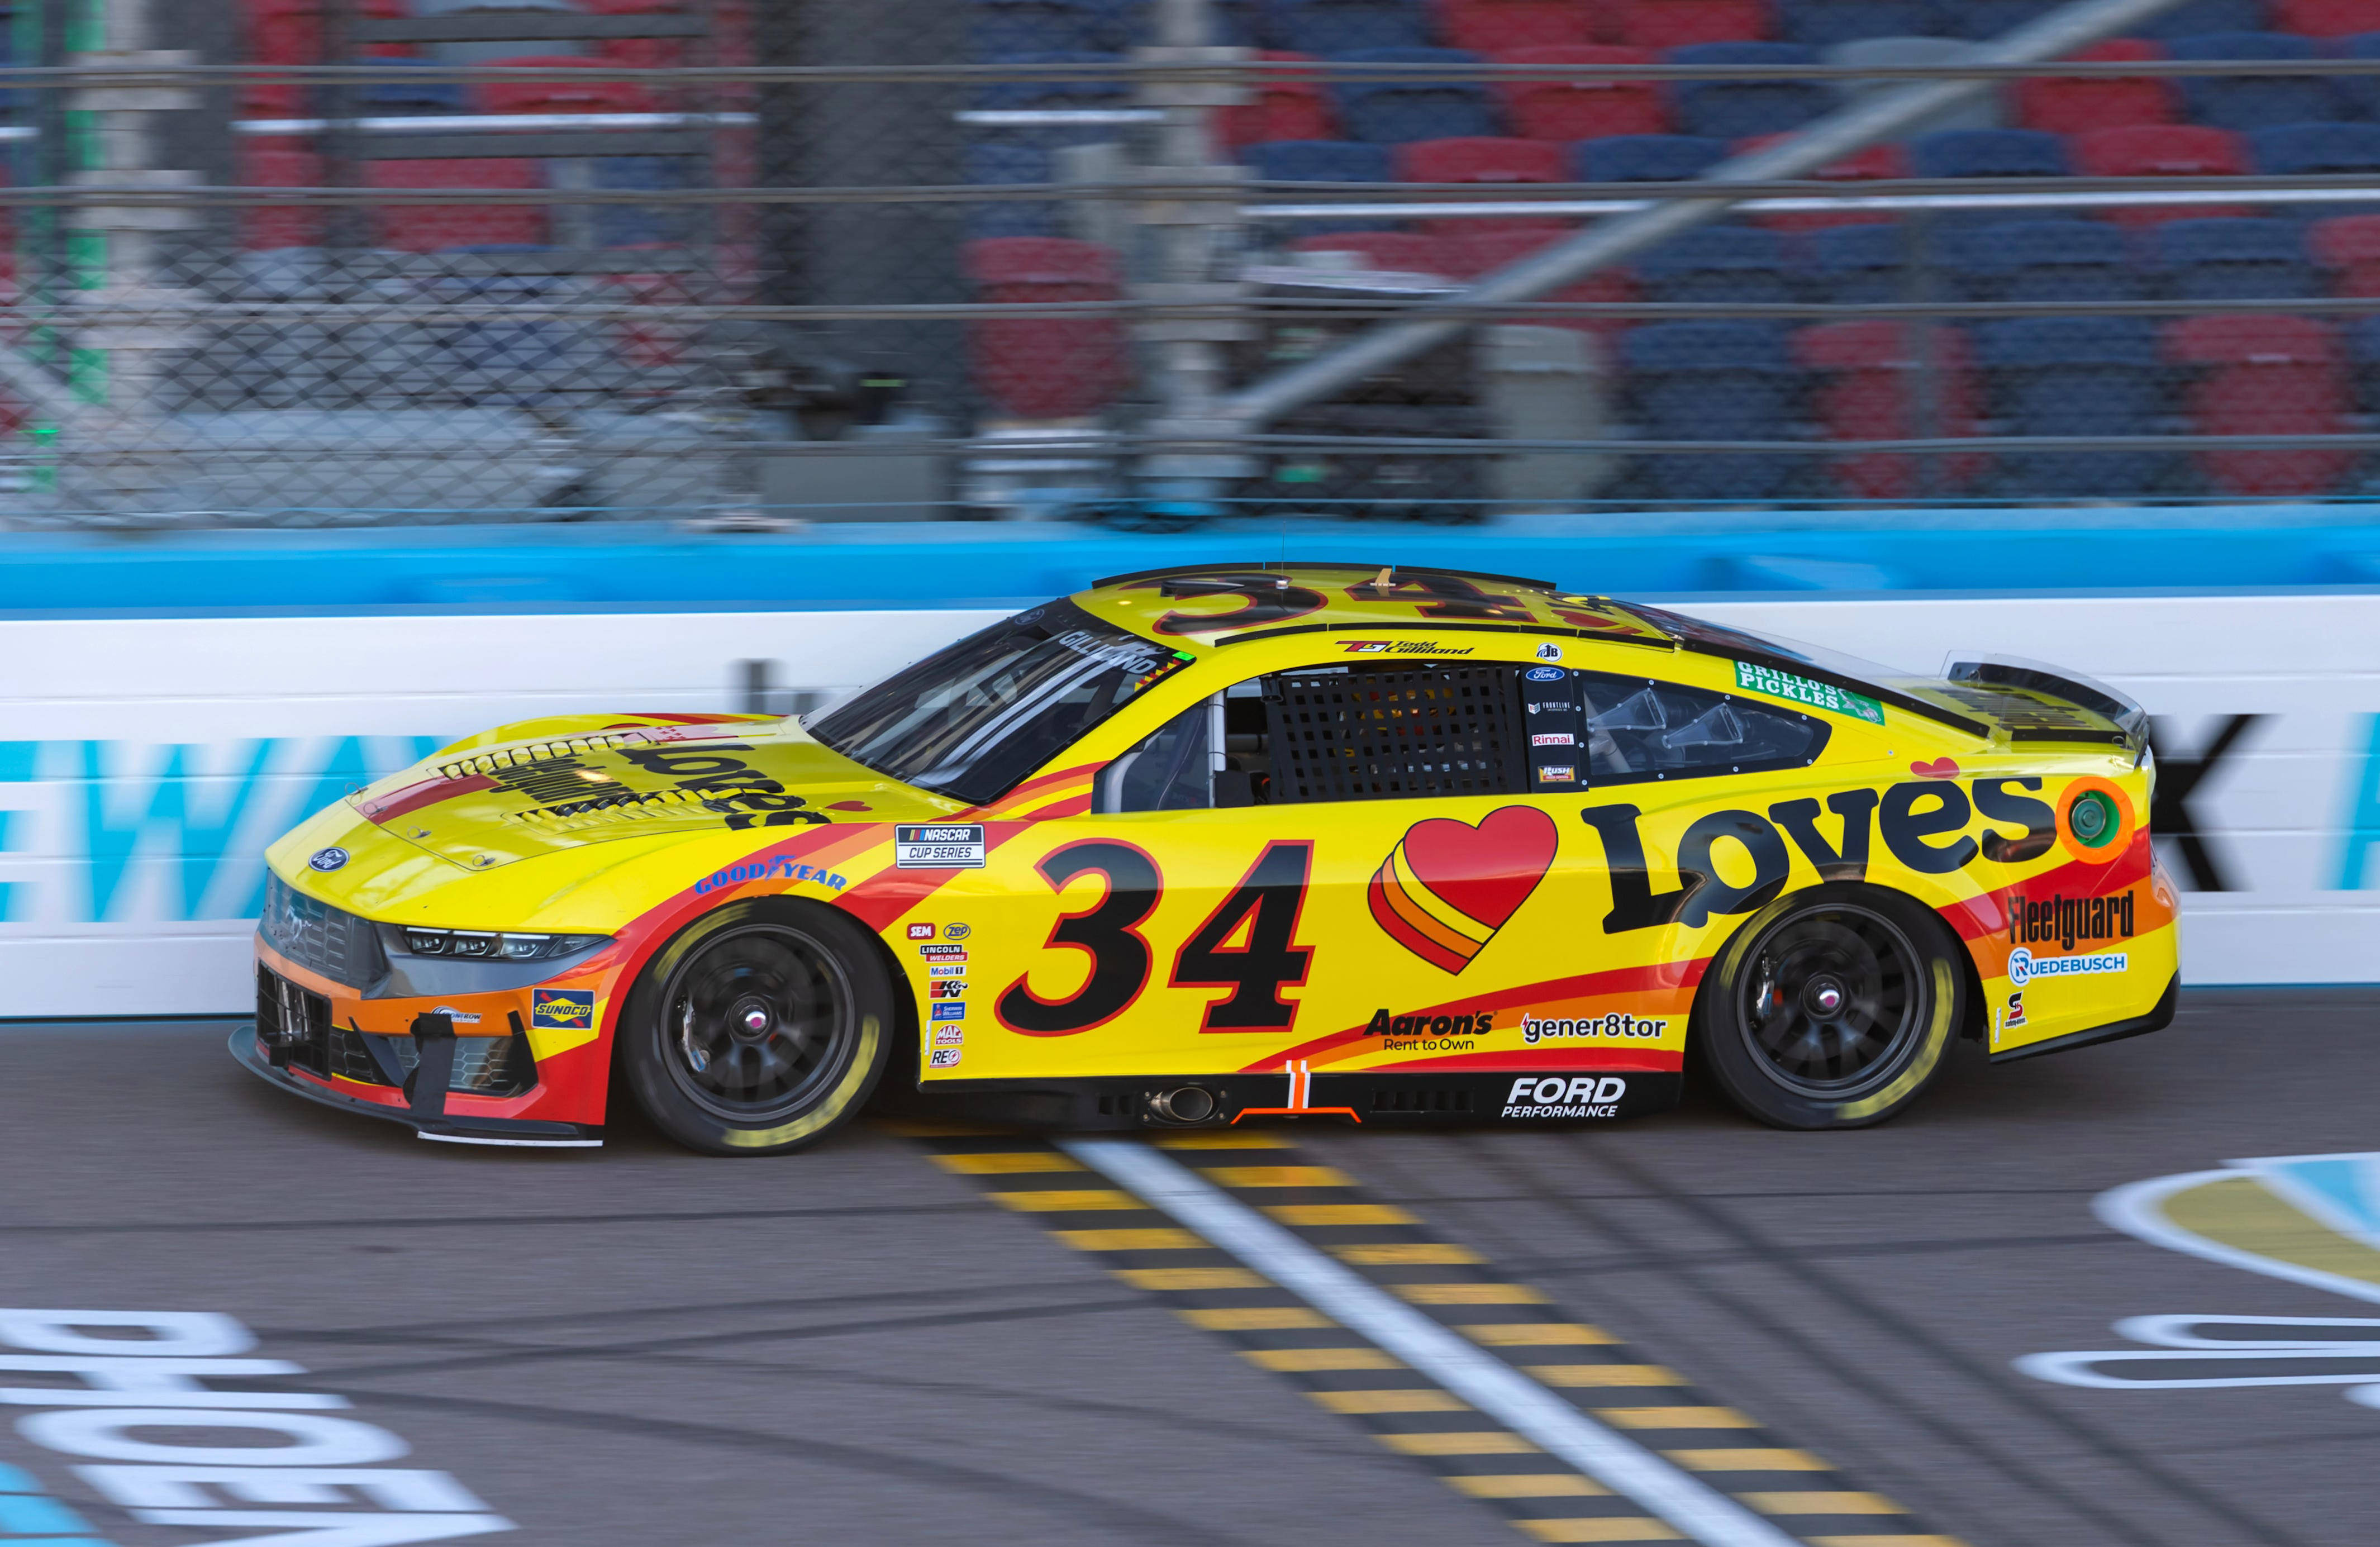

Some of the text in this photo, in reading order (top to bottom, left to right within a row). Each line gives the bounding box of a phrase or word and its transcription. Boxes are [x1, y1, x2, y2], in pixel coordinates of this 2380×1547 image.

[1384, 646, 1475, 655] Gilliland
[1737, 661, 1837, 696] GRILLO'S
[1740, 672, 1840, 710] PICKLES
[1533, 735, 1571, 745] Rinnai
[924, 829, 971, 841] NASCAR
[909, 847, 972, 859] CUP SERIES
[694, 860, 848, 895] GOODYEAR
[2007, 890, 2134, 951] Fleetguard
[910, 925, 932, 937] SEM
[994, 837, 1316, 1037] 34
[931, 967, 954, 975] Mobil
[2013, 956, 2125, 977] RUEDEBUSCH
[536, 1004, 589, 1016] SUNOCO
[1362, 1008, 1495, 1037] Aaron's
[1524, 1014, 1667, 1043] gener8tor
[1383, 1039, 1475, 1051] Rent to Own
[1506, 1077, 1626, 1104] FORD
[1501, 1105, 1619, 1118] PERFORMANCE
